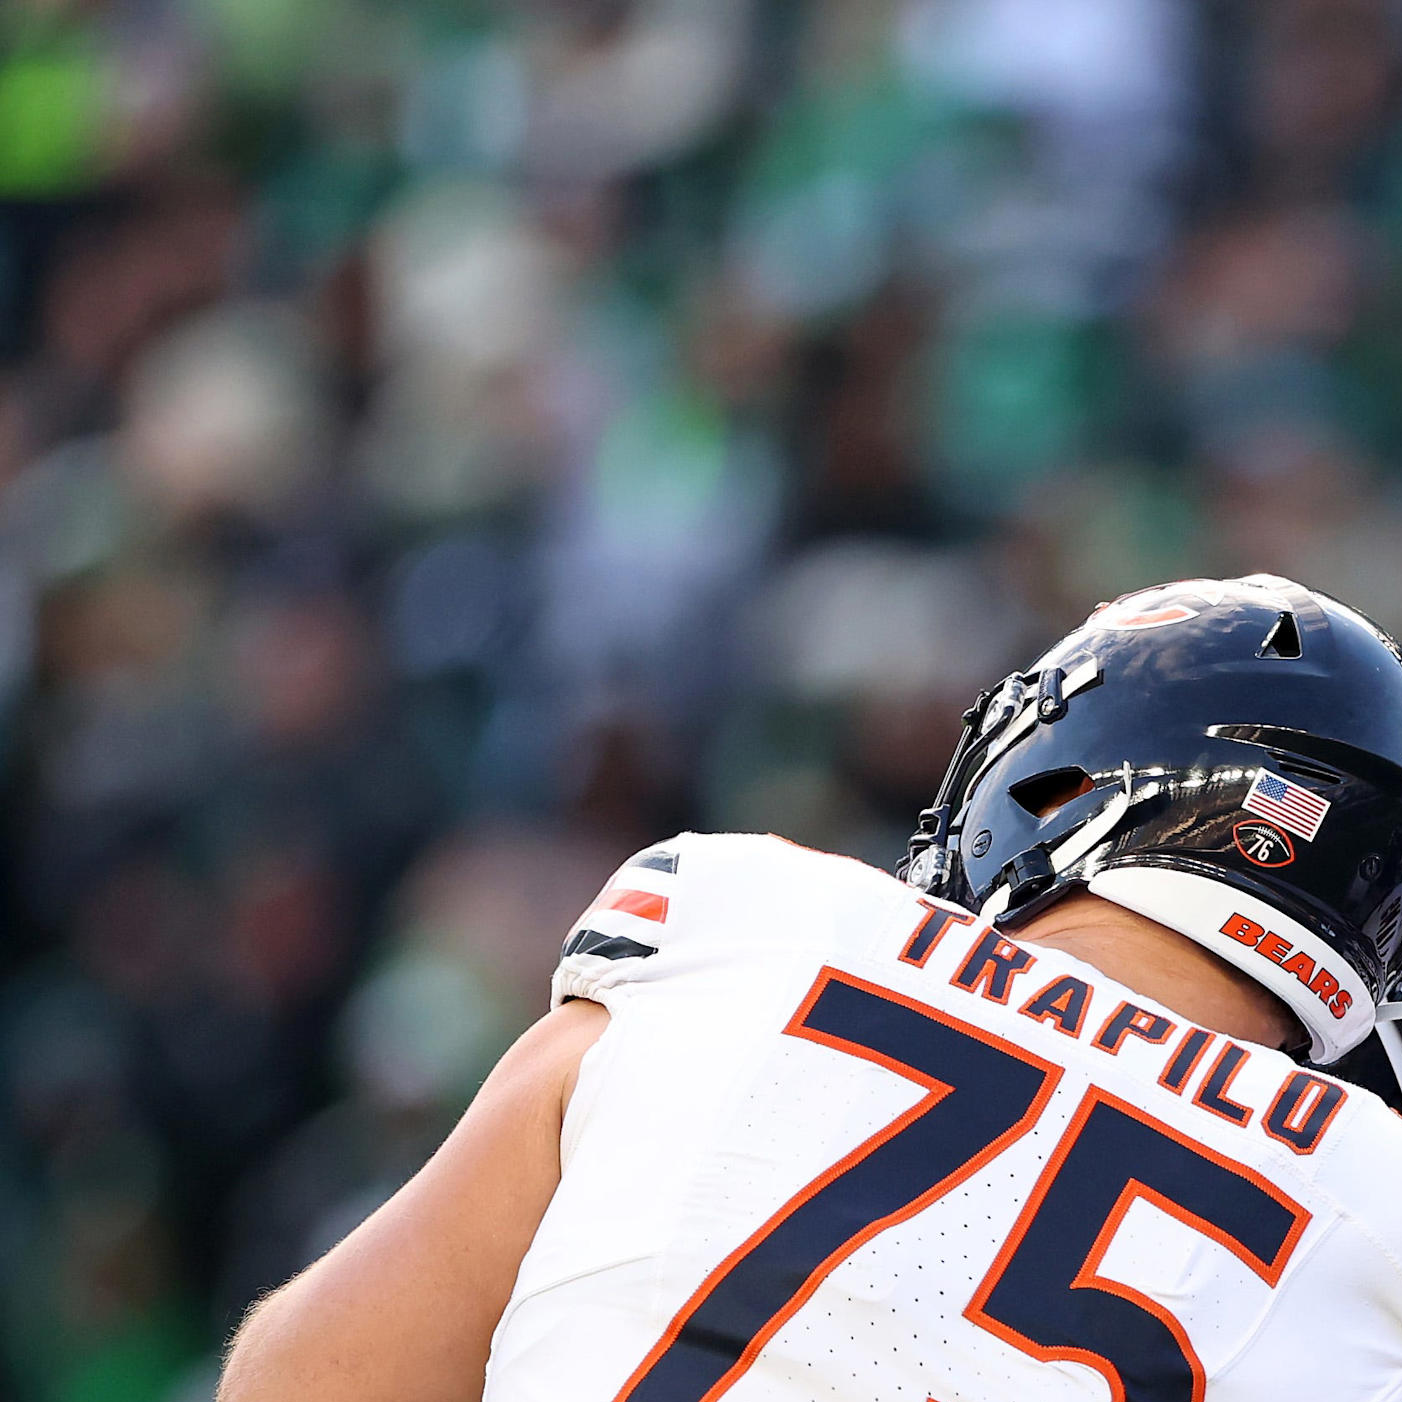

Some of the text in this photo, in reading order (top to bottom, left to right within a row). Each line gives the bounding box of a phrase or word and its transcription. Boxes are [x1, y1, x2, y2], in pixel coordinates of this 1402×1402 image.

[1246, 833, 1274, 862] 76
[1218, 912, 1353, 1020] BEARS
[896, 896, 1350, 1156] TRAPILO
